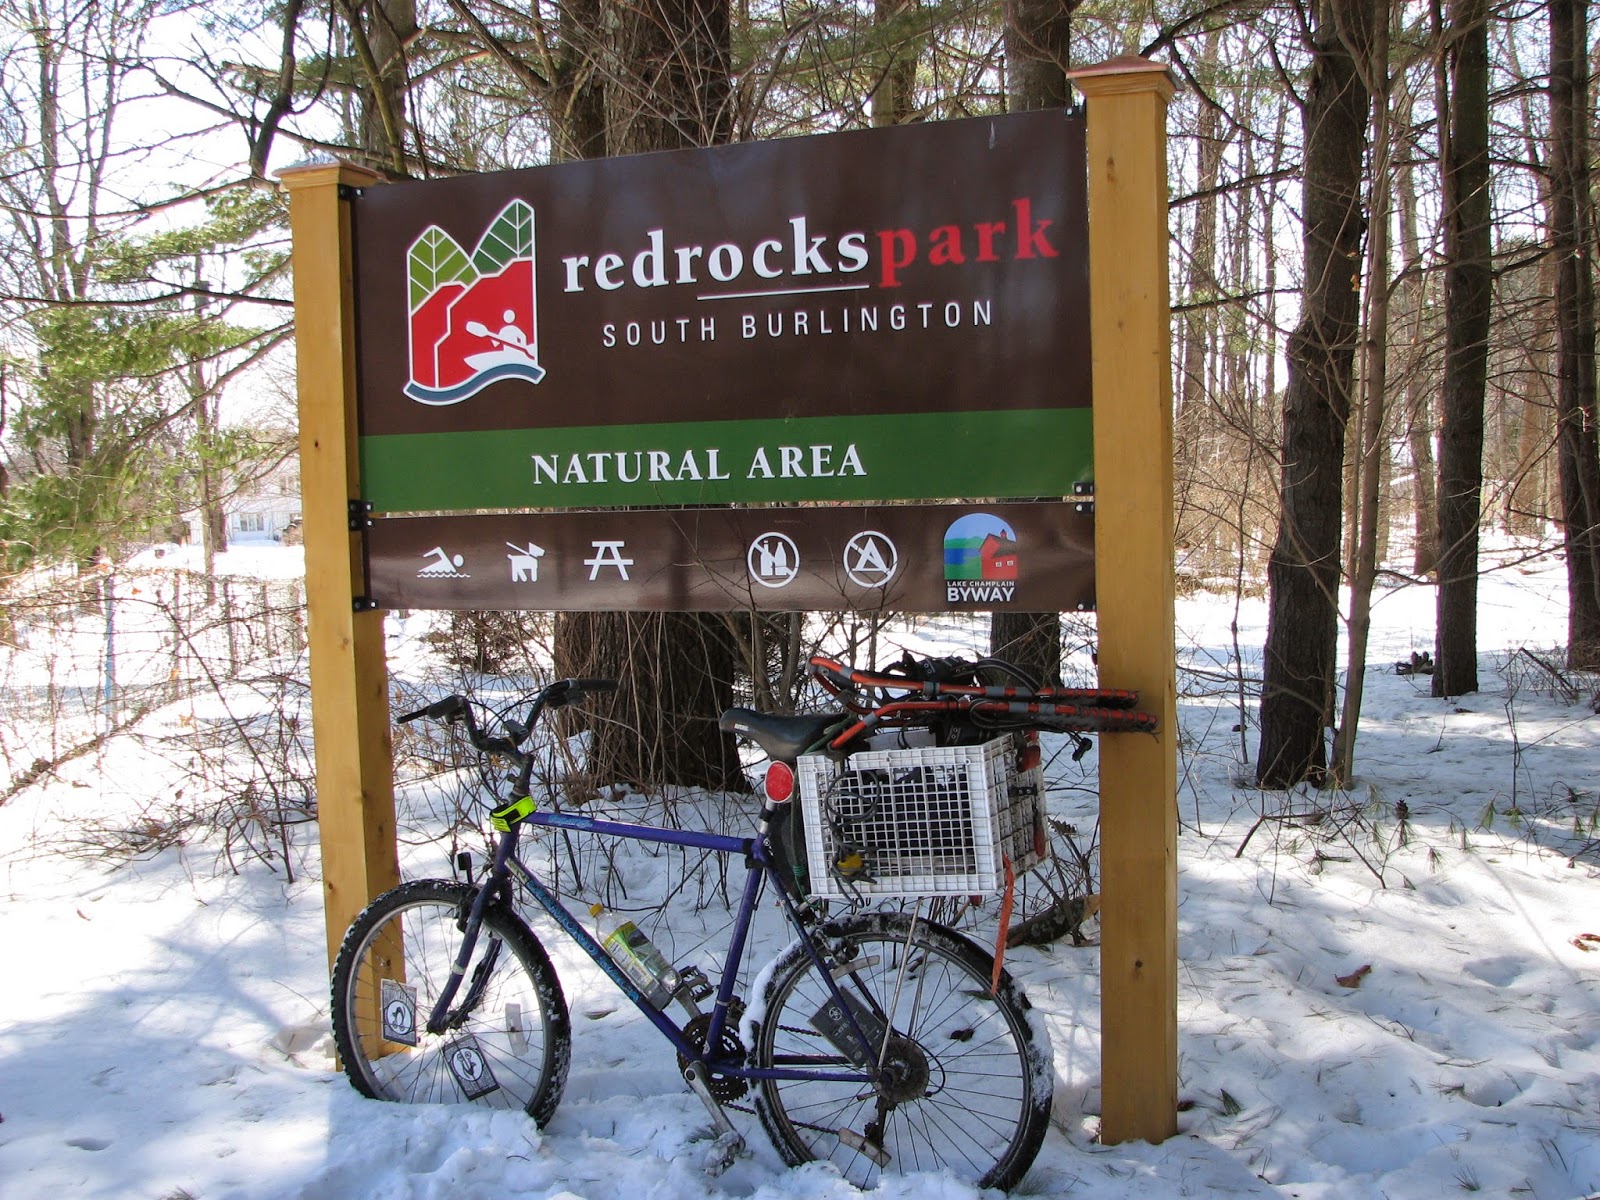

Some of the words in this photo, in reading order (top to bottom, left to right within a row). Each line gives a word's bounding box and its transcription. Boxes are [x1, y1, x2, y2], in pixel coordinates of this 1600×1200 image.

[602, 316, 717, 348] SOUTH
[741, 298, 993, 340] BURLINGTON
[530, 448, 731, 486] NATURAL
[746, 443, 868, 480] AREA
[946, 580, 967, 588] LAKE
[969, 580, 1015, 588] CHAMPLAIN
[947, 586, 1015, 602] BYWAY
